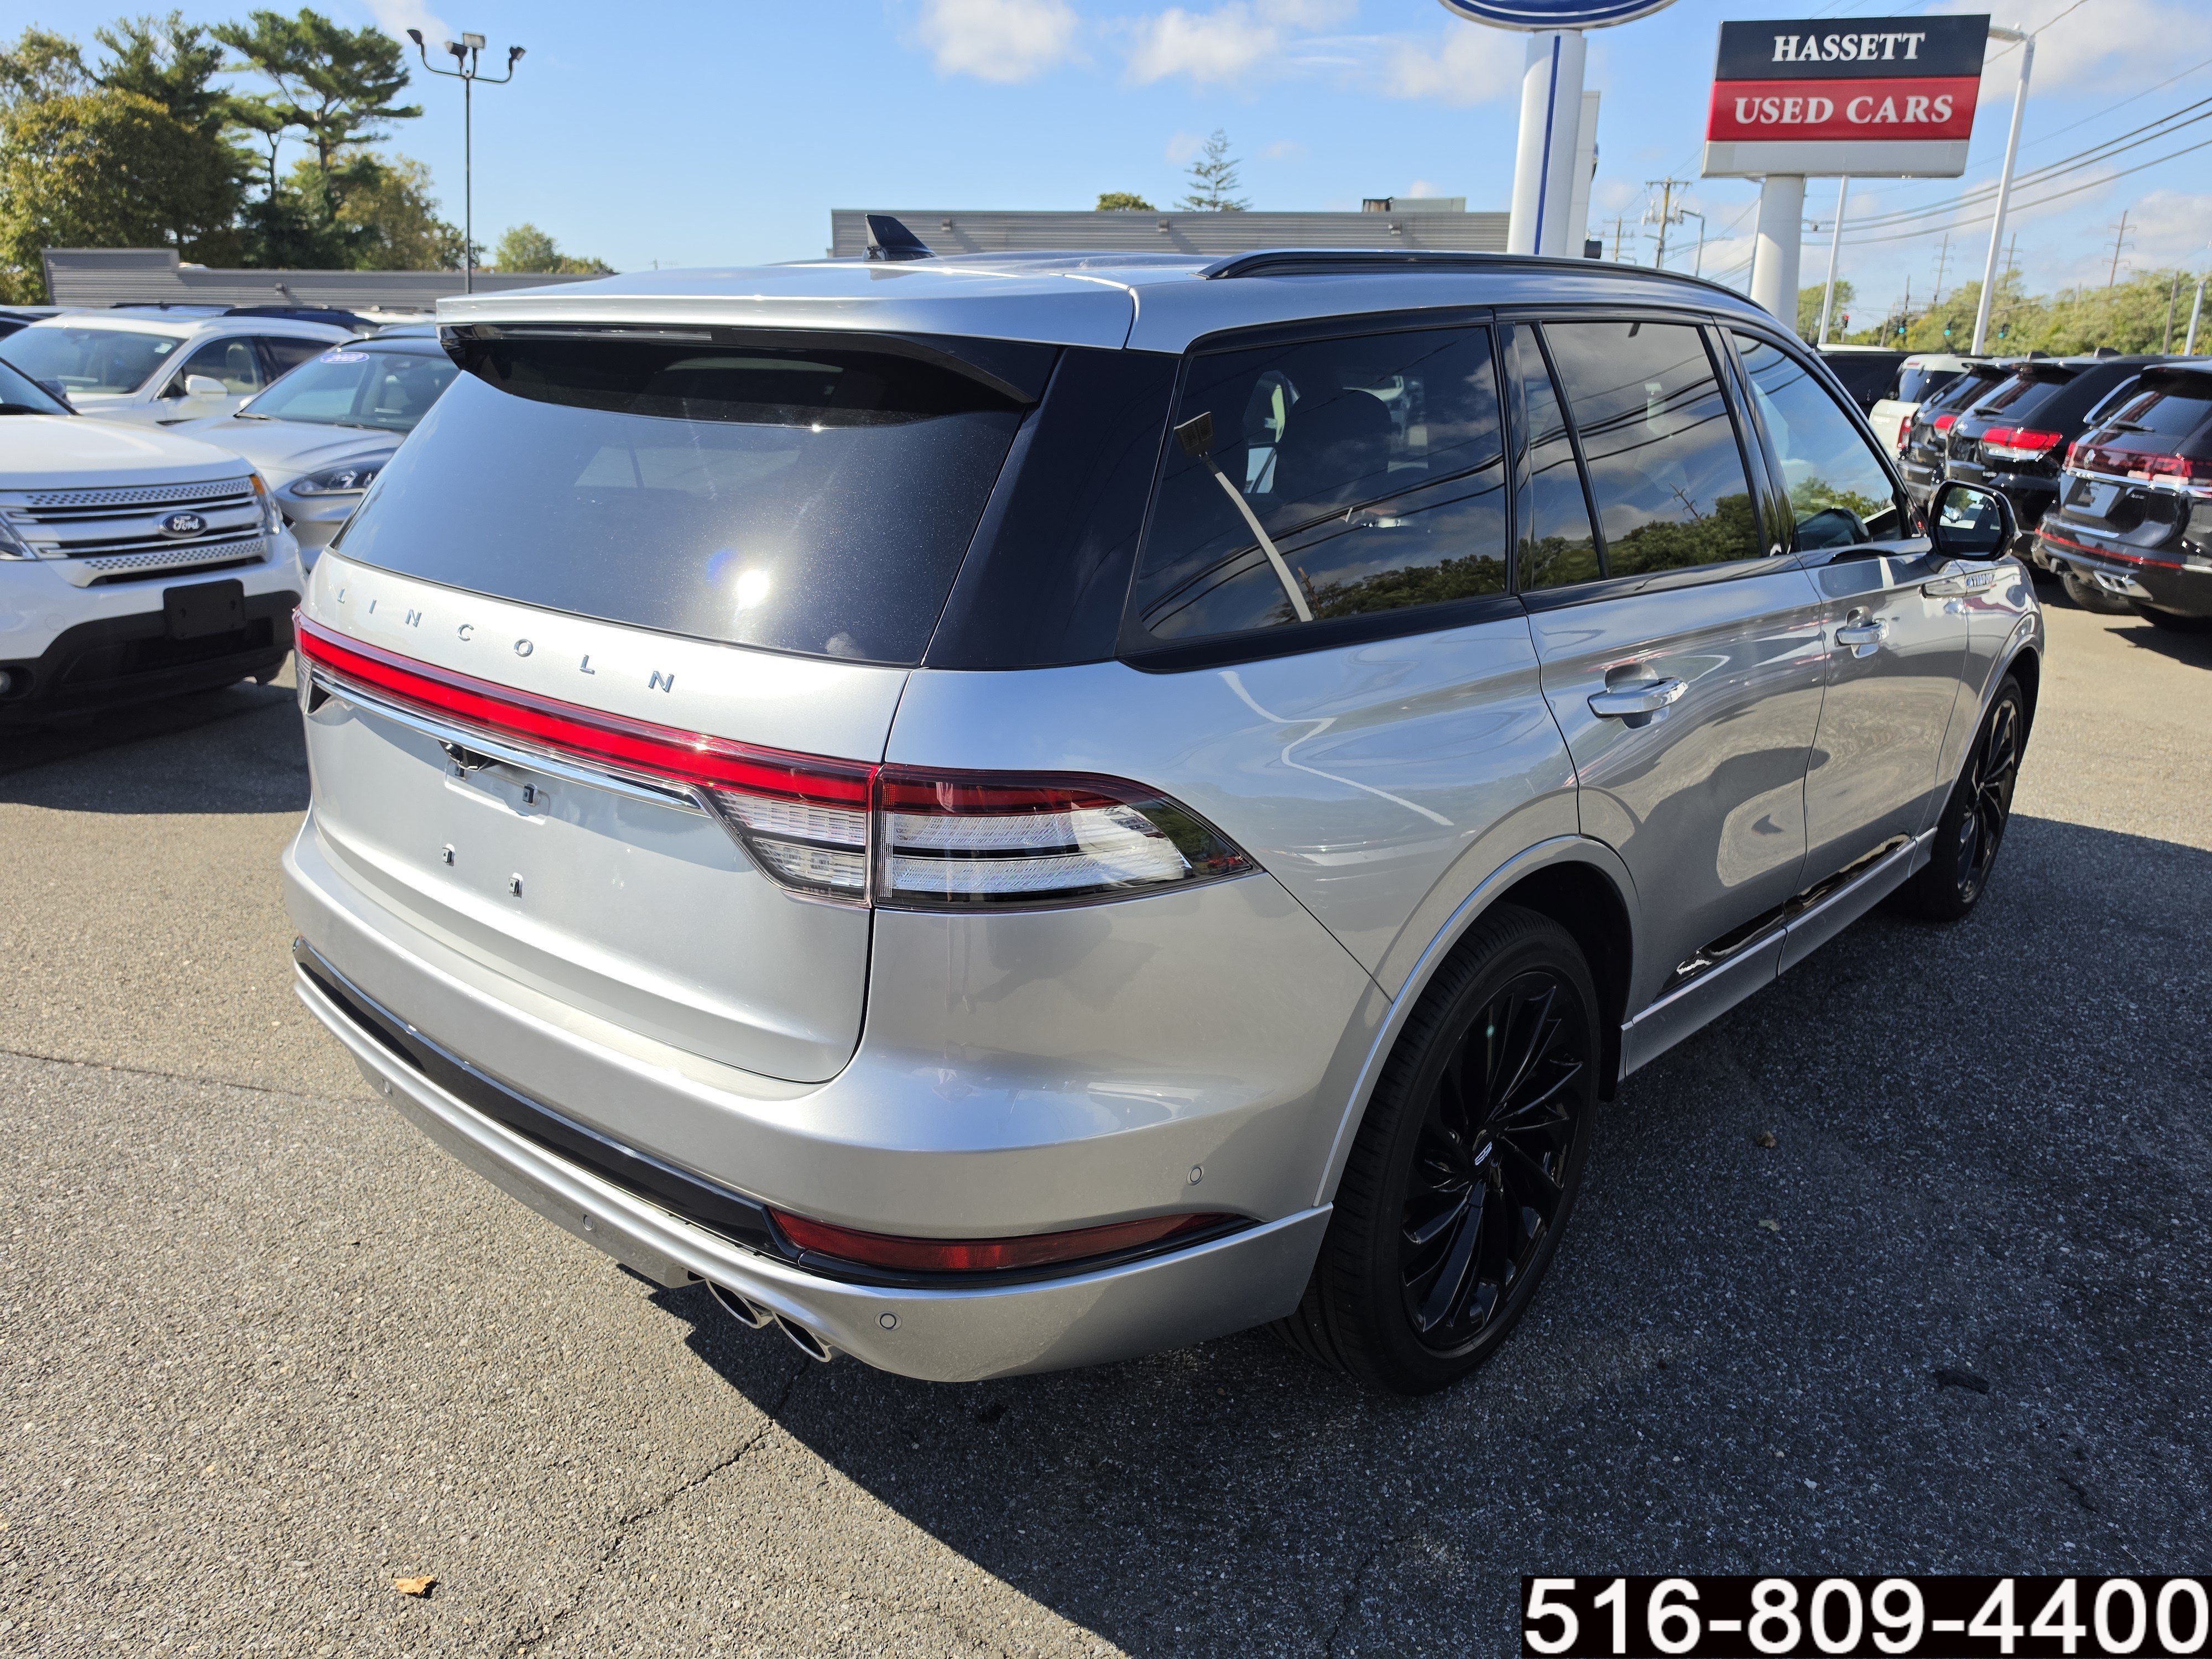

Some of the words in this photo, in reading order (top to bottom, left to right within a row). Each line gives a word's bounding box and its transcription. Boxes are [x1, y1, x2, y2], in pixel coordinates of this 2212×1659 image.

[1771, 32, 1926, 62] HASSETT
[1735, 96, 1834, 124] USED
[1846, 94, 1953, 123] CARS
[173, 515, 200, 531] Ford
[337, 587, 675, 693] LINCOLN
